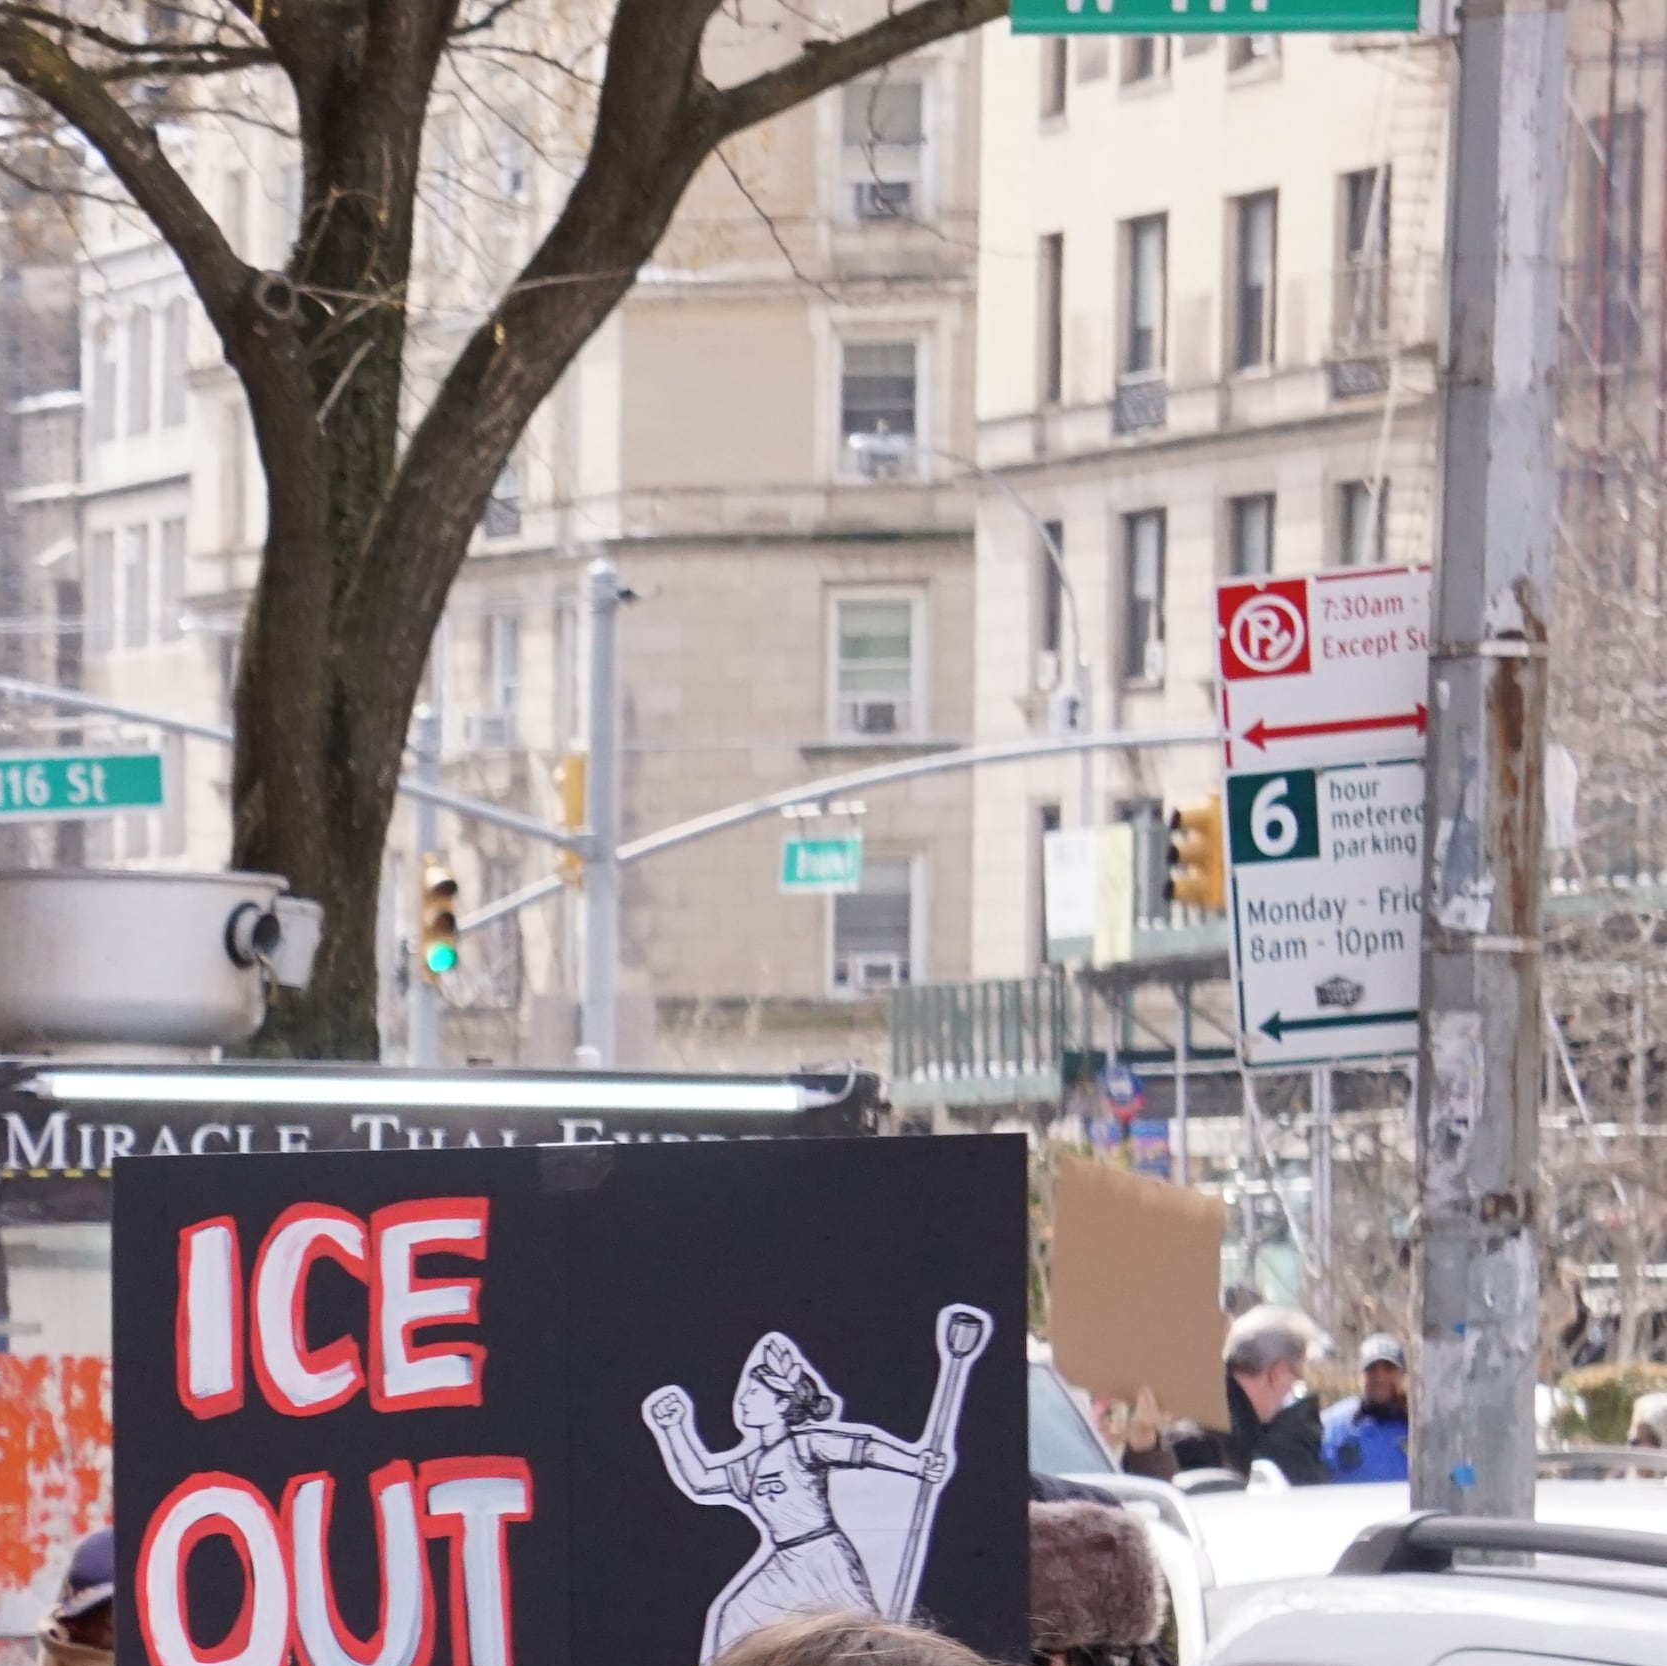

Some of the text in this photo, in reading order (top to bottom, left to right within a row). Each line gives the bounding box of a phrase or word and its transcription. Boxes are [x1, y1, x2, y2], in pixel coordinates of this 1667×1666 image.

[1321, 595, 1405, 622] 7:30am
[1321, 629, 1399, 660] Except
[66, 762, 107, 804] St
[1329, 779, 1381, 802] hour
[1250, 777, 1299, 857] 6
[1332, 830, 1417, 862] parking
[1247, 894, 1347, 927] Monday
[1250, 935, 1308, 964] 8am
[1335, 928, 1405, 960] 10pm
[176, 1197, 490, 1419] ICE
